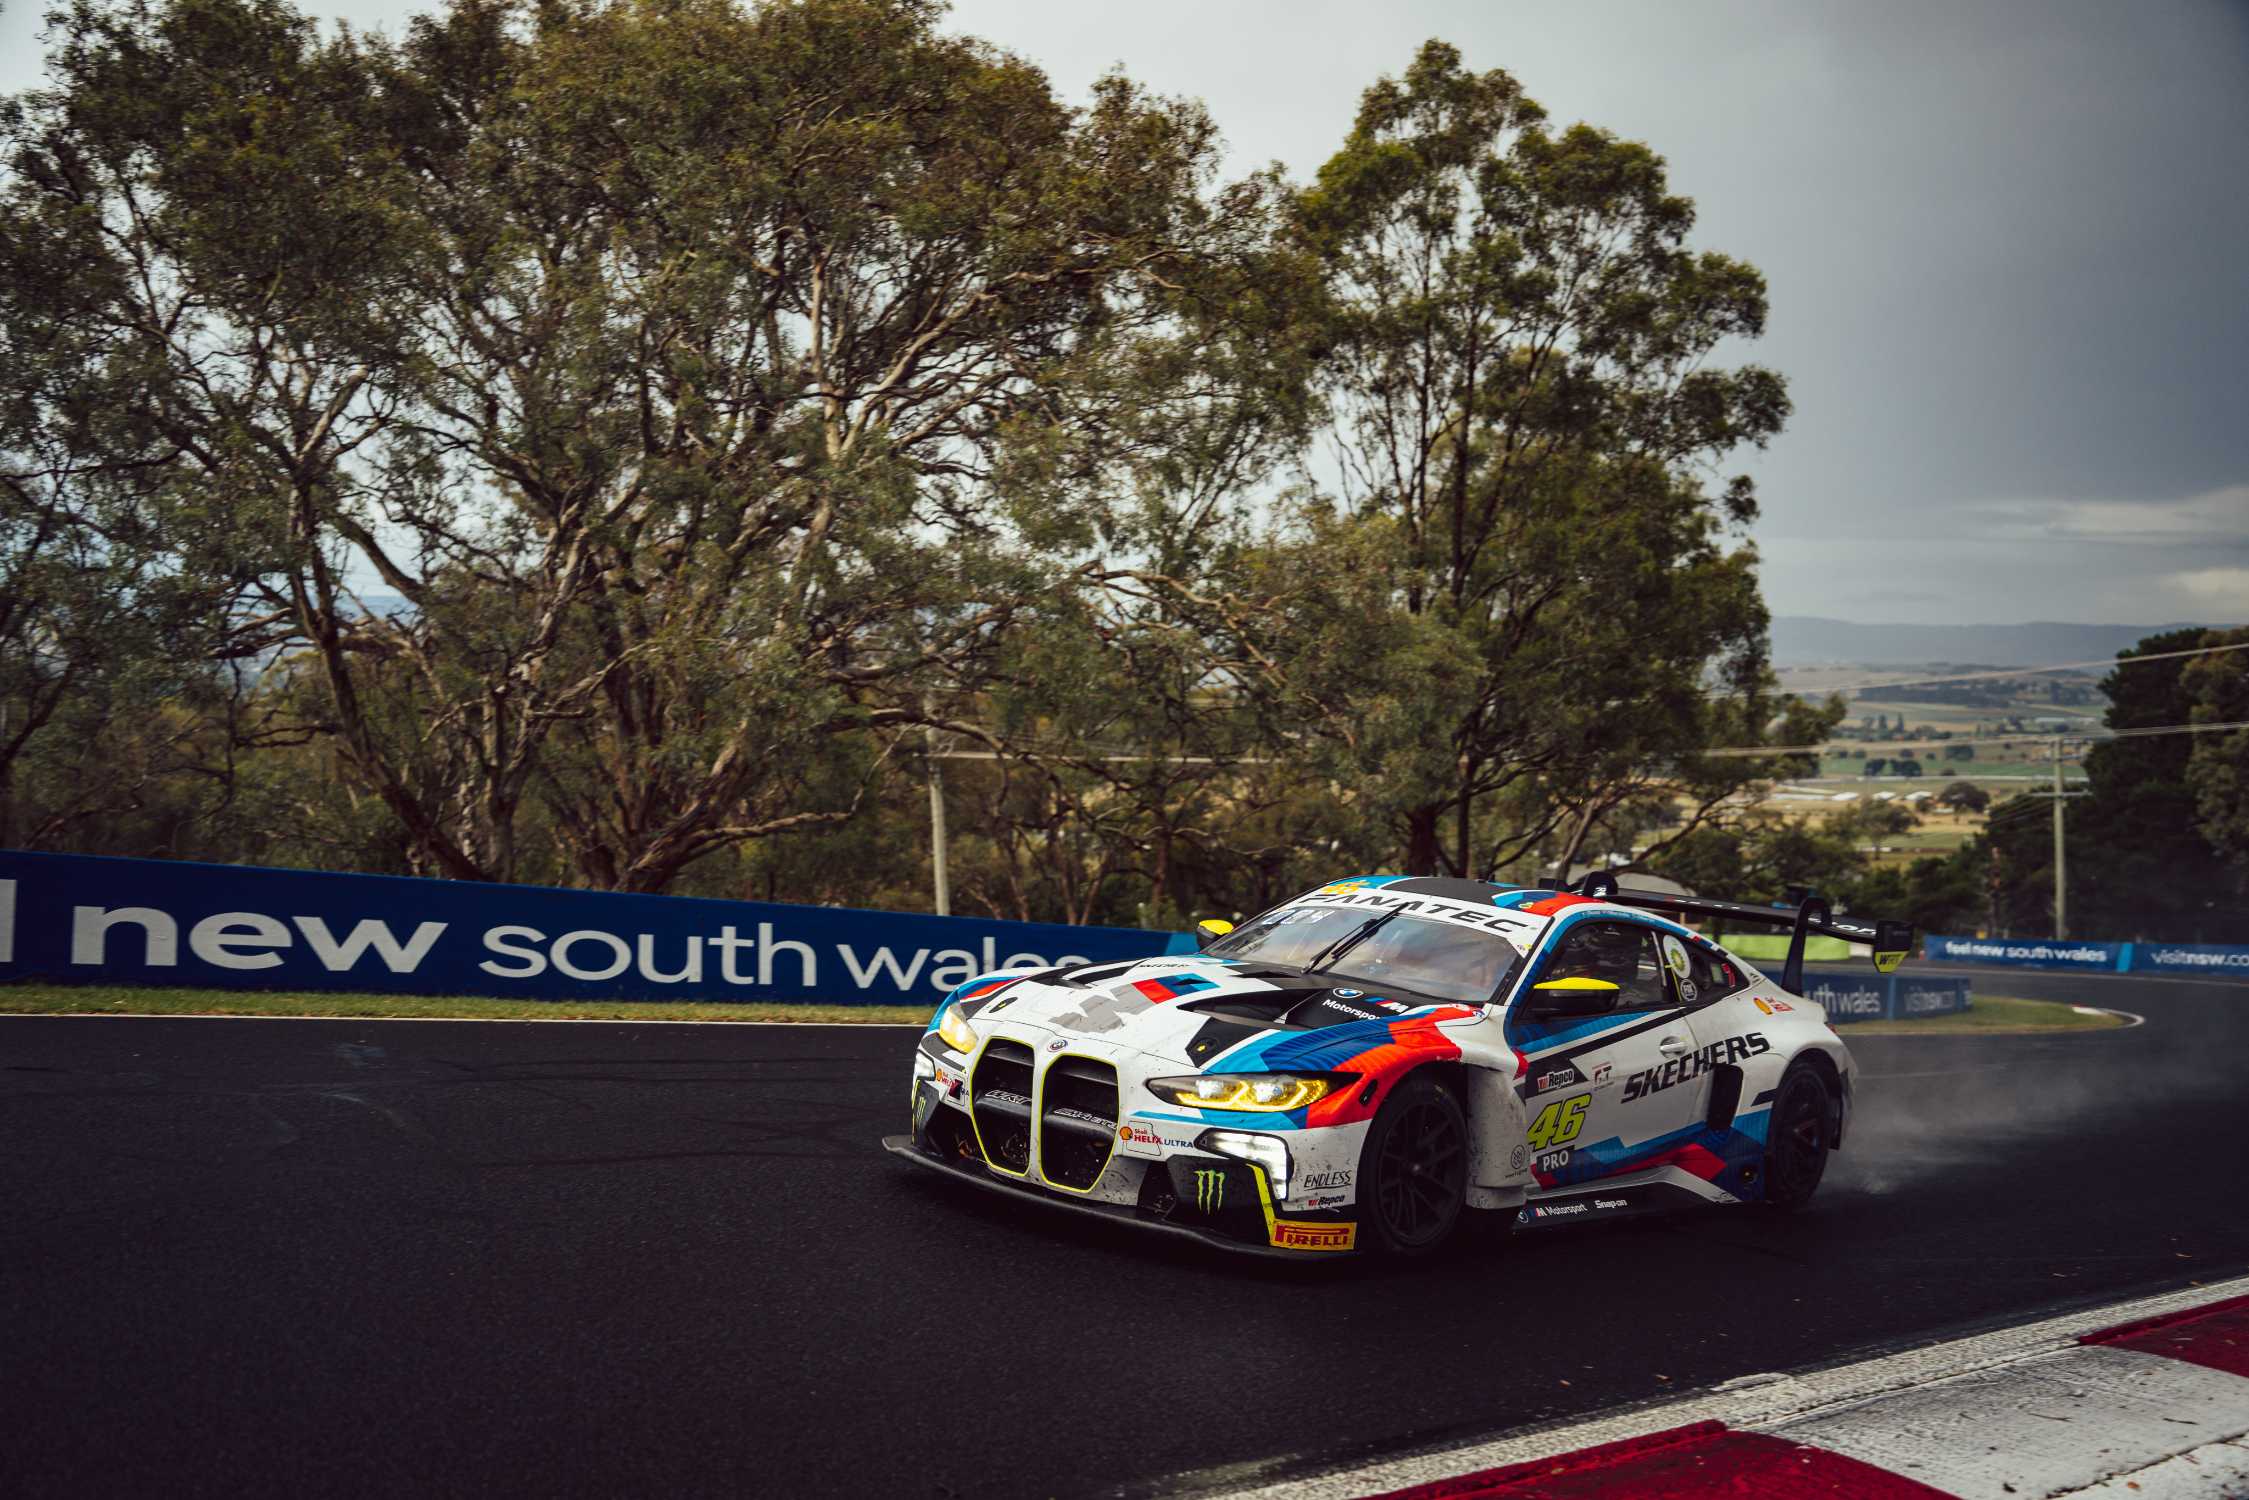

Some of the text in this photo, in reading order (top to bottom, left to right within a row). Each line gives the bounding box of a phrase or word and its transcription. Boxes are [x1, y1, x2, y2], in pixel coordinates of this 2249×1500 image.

[1299, 893, 1529, 933] FANATEC
[71, 906, 448, 973] new
[477, 922, 817, 987] south
[1972, 945, 2004, 957] new
[2006, 945, 2053, 960] south
[2054, 947, 2107, 962] wales
[1322, 999, 1380, 1020] Motorspo
[1837, 985, 1881, 1013] wales
[1620, 1032, 1770, 1104] SKECHERS
[1549, 1070, 1573, 1088] Repco
[1527, 1092, 1592, 1152] 46
[1134, 1134, 1194, 1149] HELIX ULTRA
[1542, 1150, 1569, 1171] PRO
[1303, 1169, 1352, 1188] ENDLESS
[1545, 1203, 1588, 1216] Motorsport
[1275, 1224, 1350, 1247] PIRELLI
